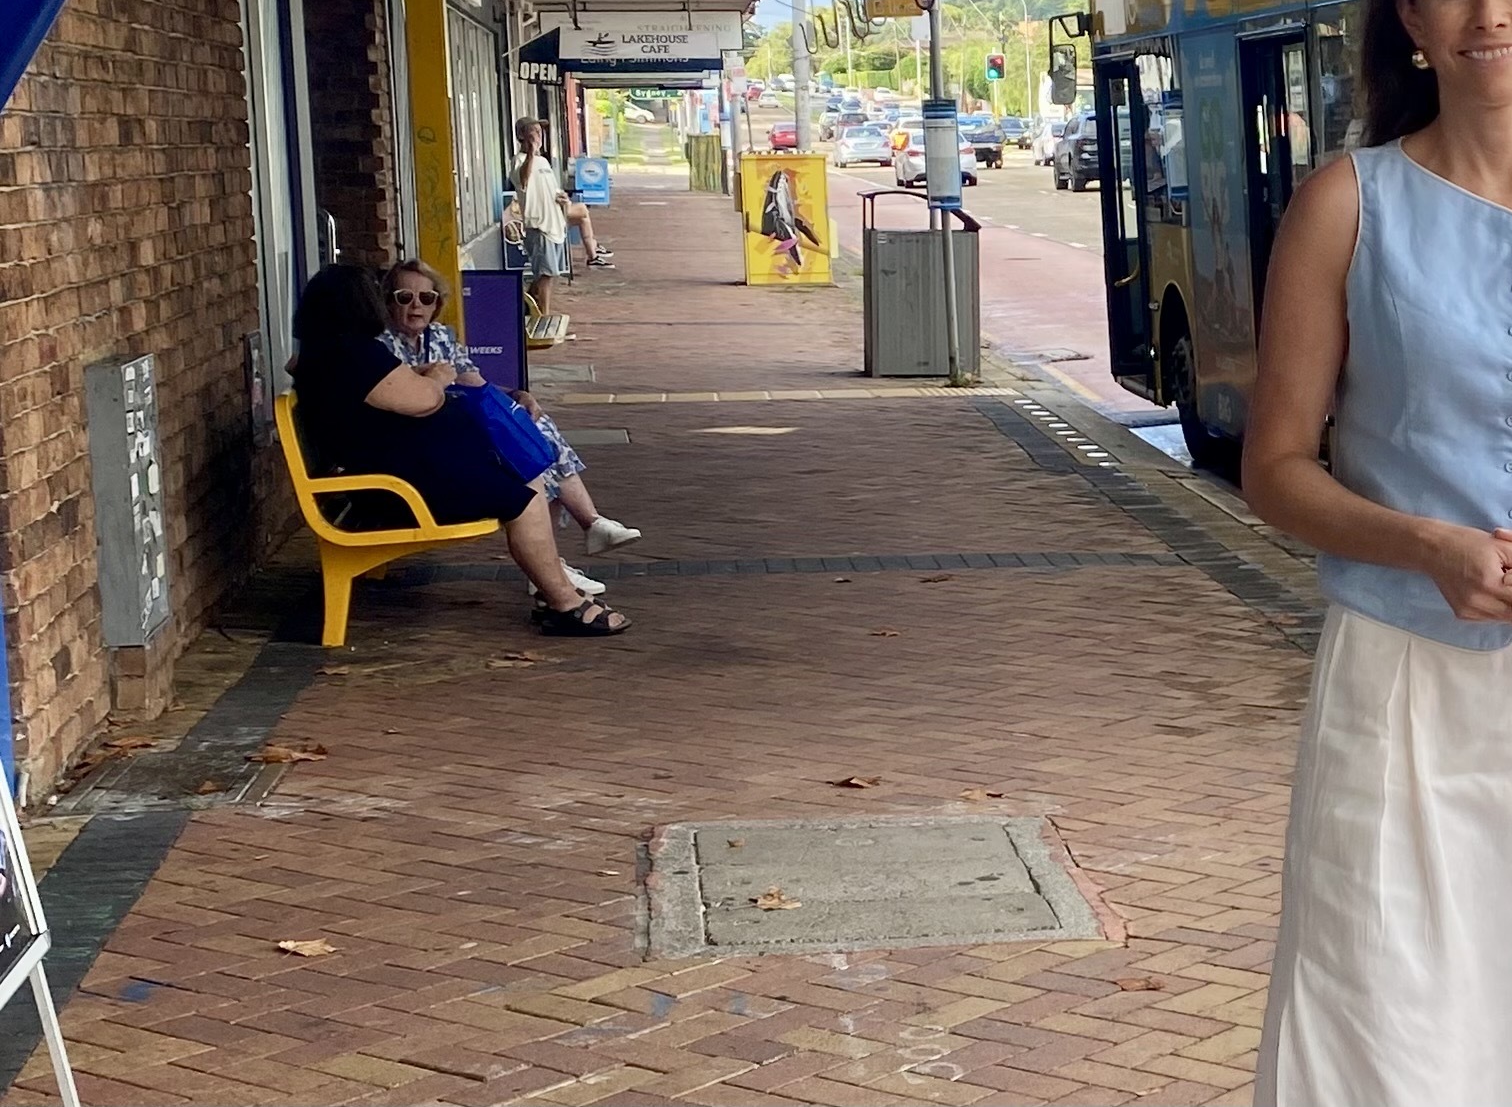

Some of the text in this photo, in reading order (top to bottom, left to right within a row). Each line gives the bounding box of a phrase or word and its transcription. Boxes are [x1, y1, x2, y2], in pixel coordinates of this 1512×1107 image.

[621, 34, 689, 44] LAKEHOUSE
[641, 44, 670, 54] CAFE
[519, 61, 558, 82] OPEN
[470, 346, 503, 354] WEEKS
